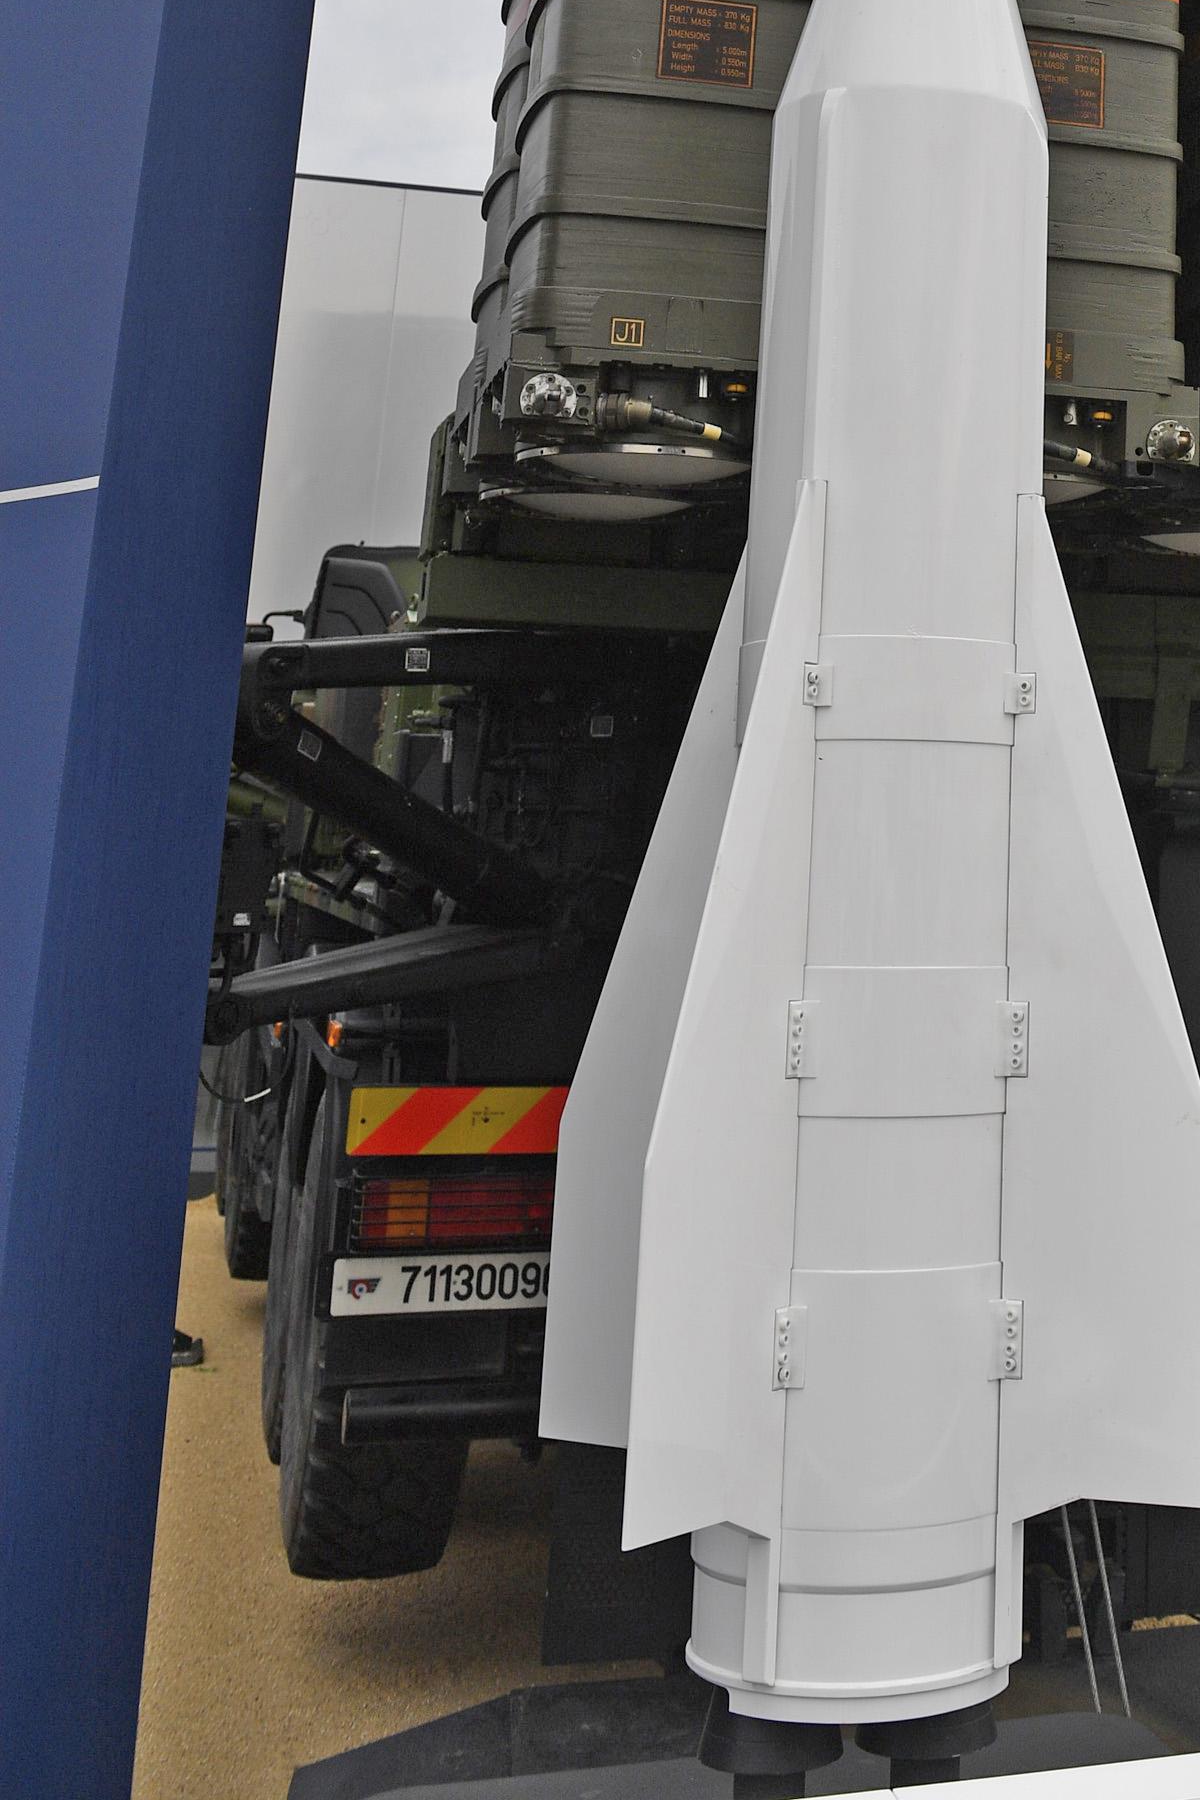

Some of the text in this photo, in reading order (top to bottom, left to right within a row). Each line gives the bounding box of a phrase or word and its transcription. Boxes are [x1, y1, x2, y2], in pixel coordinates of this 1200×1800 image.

[669, 4, 693, 14] EMPTY
[697, 8, 718, 17] MASS
[669, 15, 688, 25] FULL
[691, 18, 712, 27] MASS
[668, 29, 711, 40] DIMENSIONS
[672, 41, 699, 51] Length
[670, 62, 695, 73] Height
[616, 322, 636, 343] J1
[401, 1261, 551, 1304] 7113009
